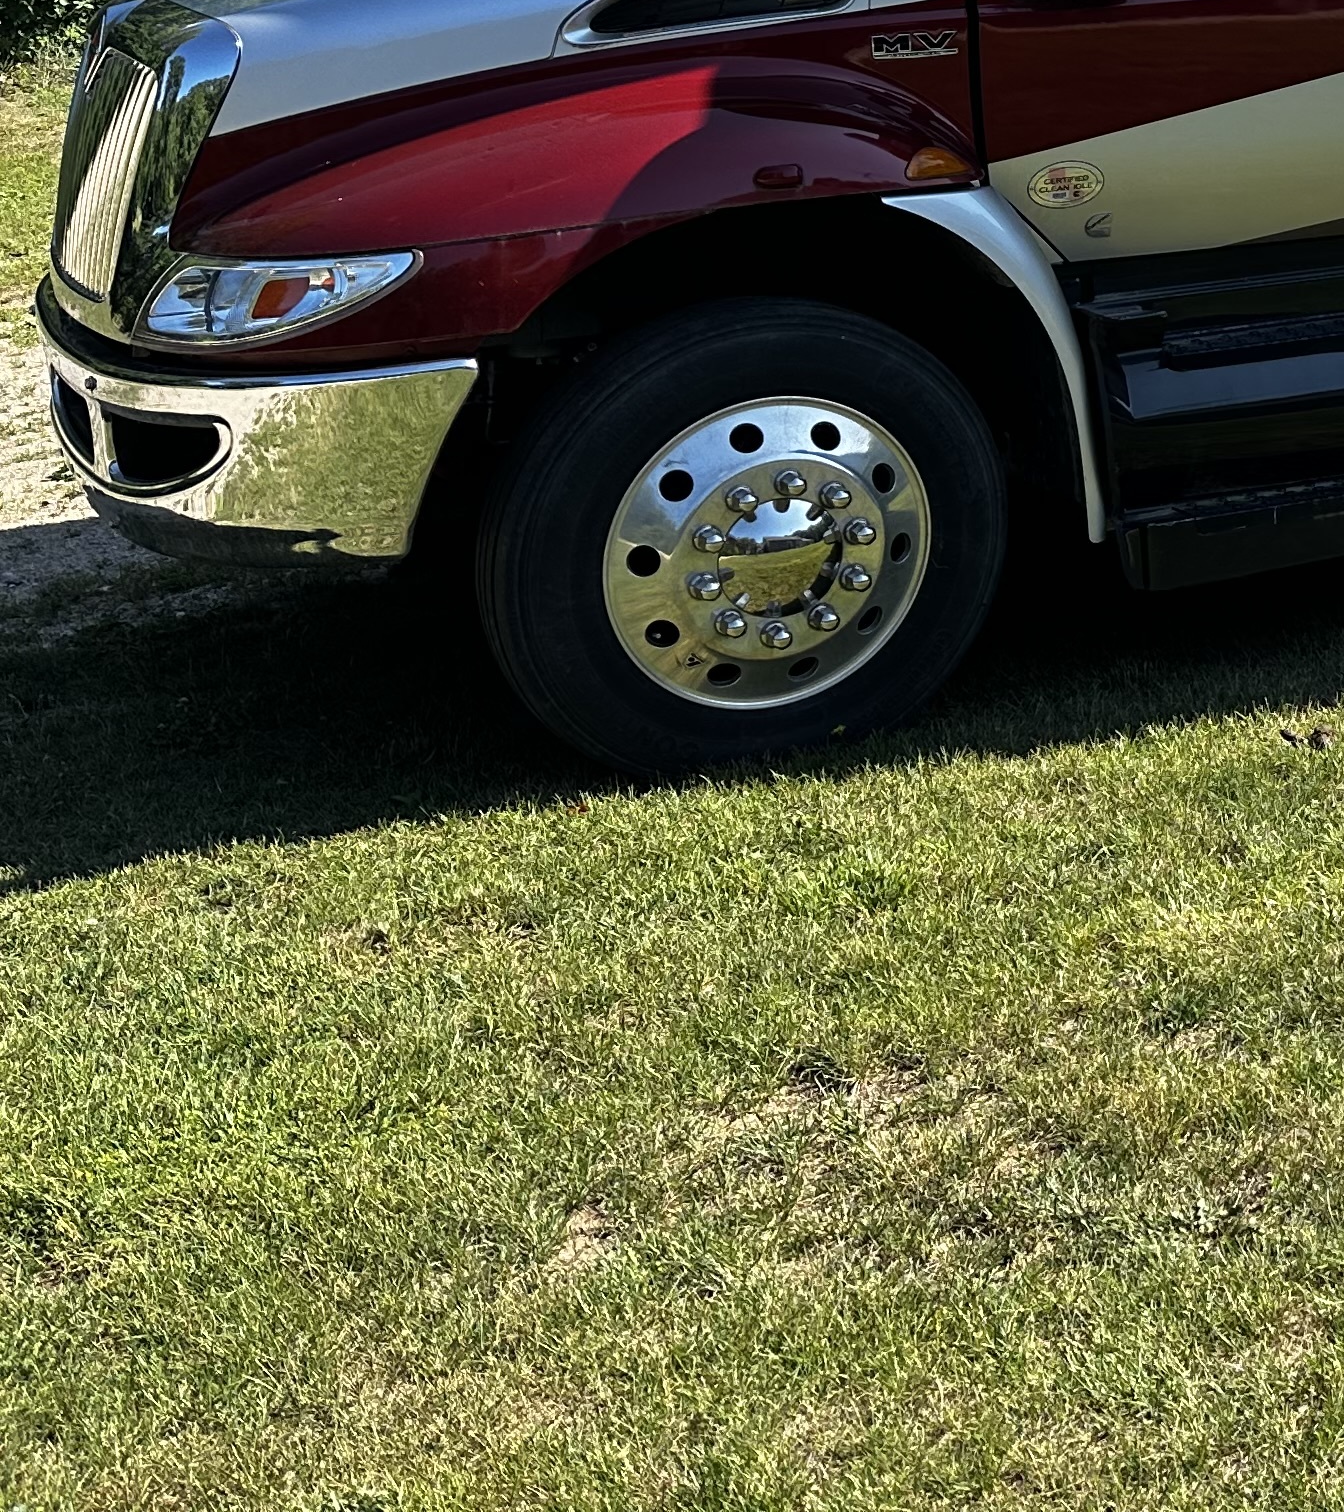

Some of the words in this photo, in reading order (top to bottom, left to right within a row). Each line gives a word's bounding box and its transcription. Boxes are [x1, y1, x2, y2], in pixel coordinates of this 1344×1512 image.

[871, 30, 958, 53] MV
[1043, 174, 1090, 185] CERTIFIED
[1038, 183, 1070, 194] CLEAN
[1073, 181, 1093, 190] IDLE
